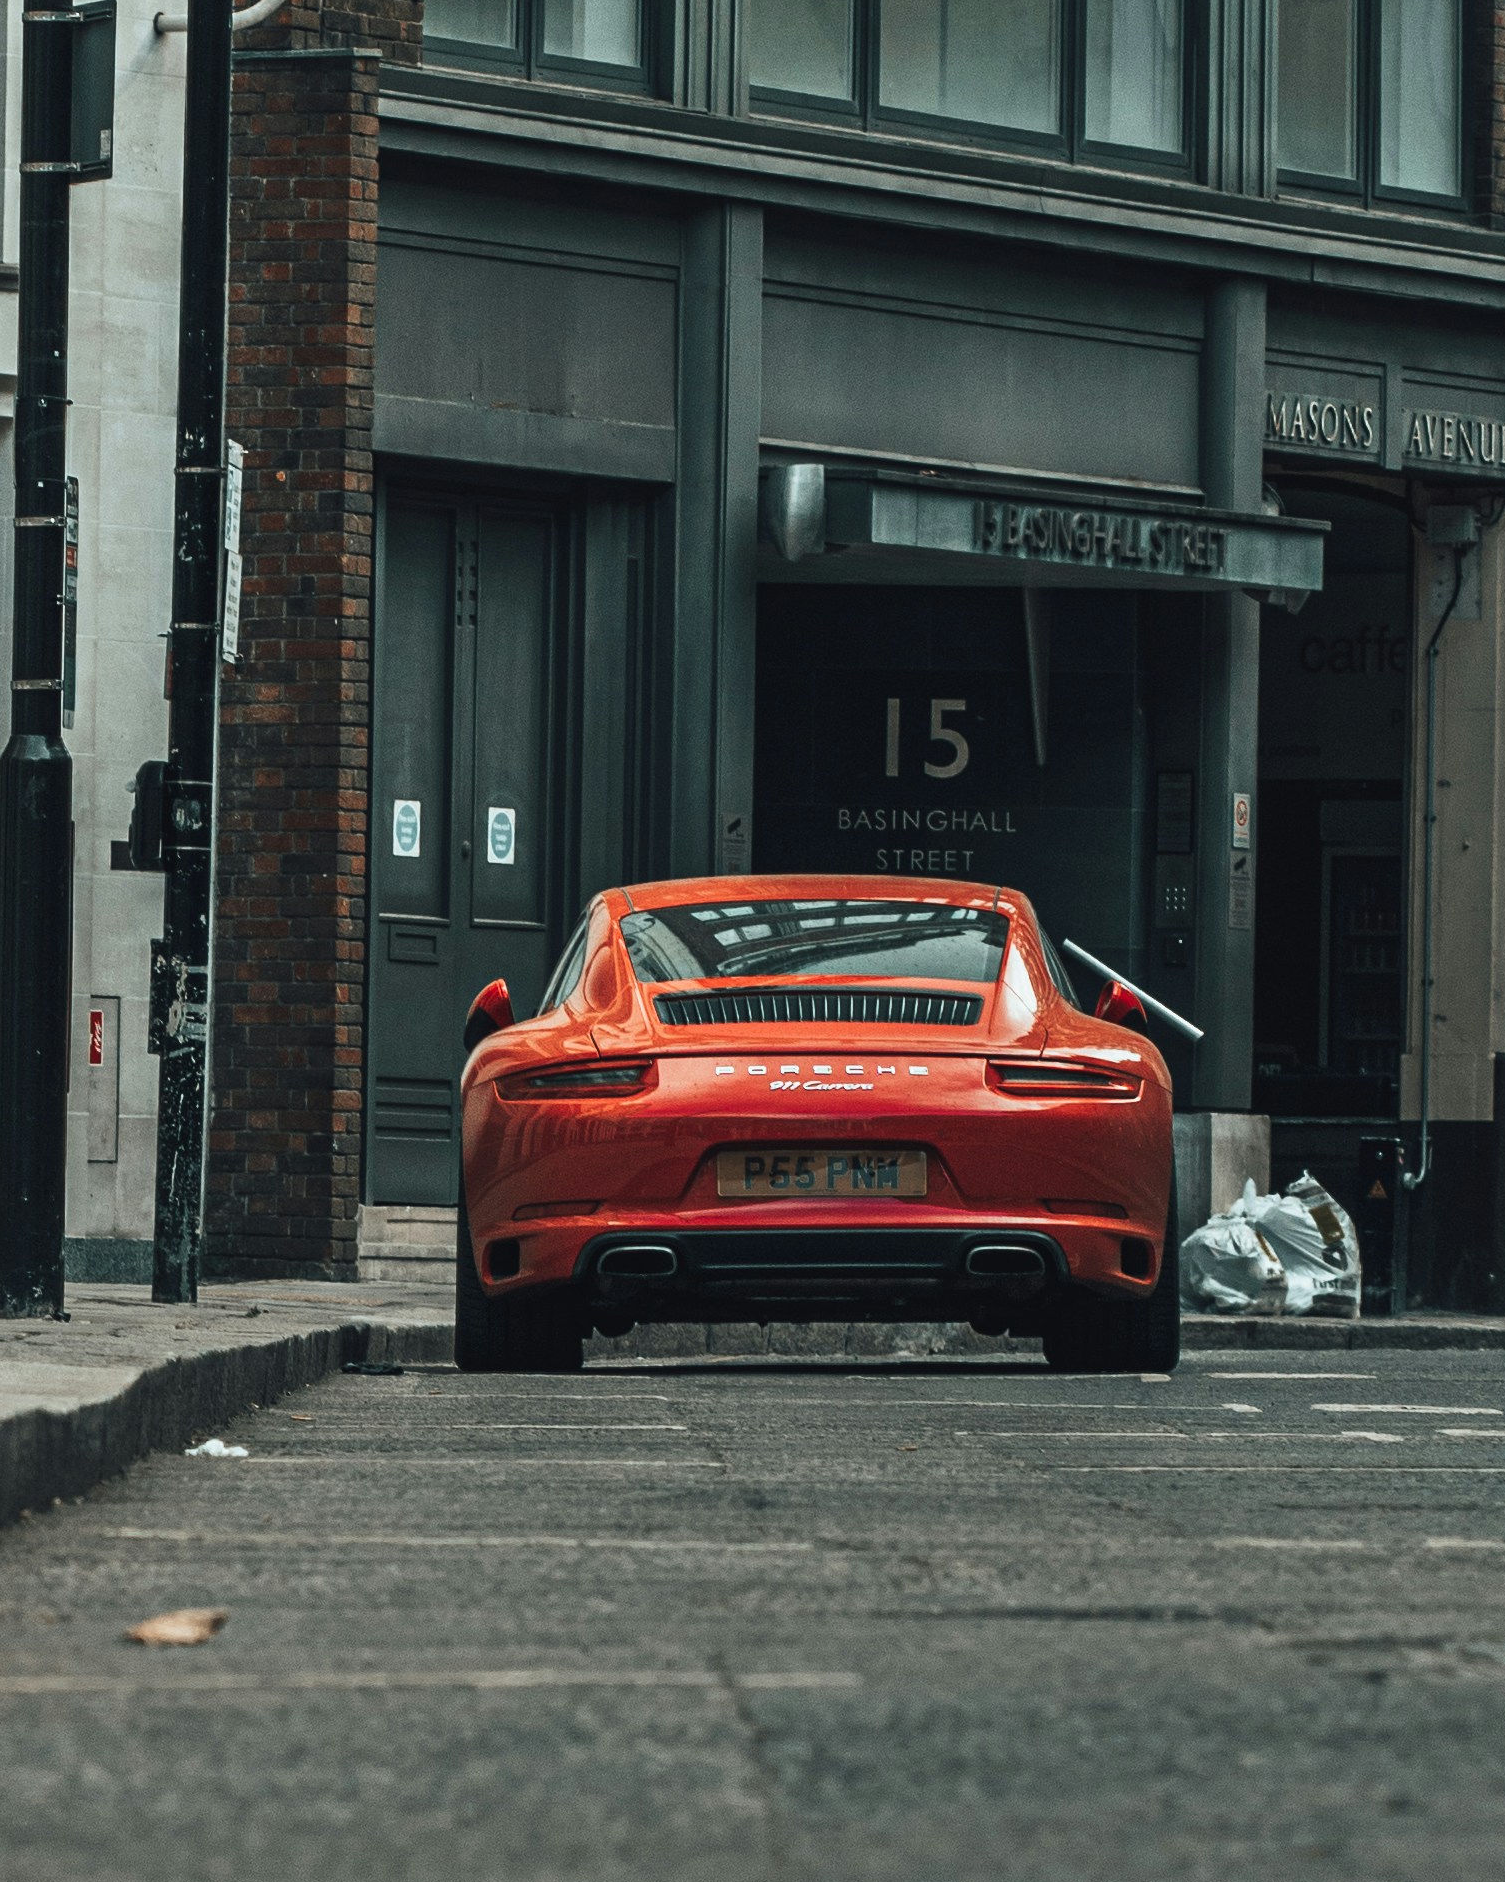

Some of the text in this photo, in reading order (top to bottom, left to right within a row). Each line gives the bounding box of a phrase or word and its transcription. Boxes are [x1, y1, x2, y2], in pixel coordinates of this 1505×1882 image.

[1264, 392, 1373, 449] MASONS
[1001, 503, 1143, 562] BASINGHALL
[1148, 519, 1232, 572] STREET
[885, 697, 970, 779] 15
[837, 808, 1017, 833] BASINGHALL
[875, 848, 975, 872] STREET
[715, 1065, 929, 1076] PORSCHE
[769, 1080, 874, 1091] 911 Carrera
